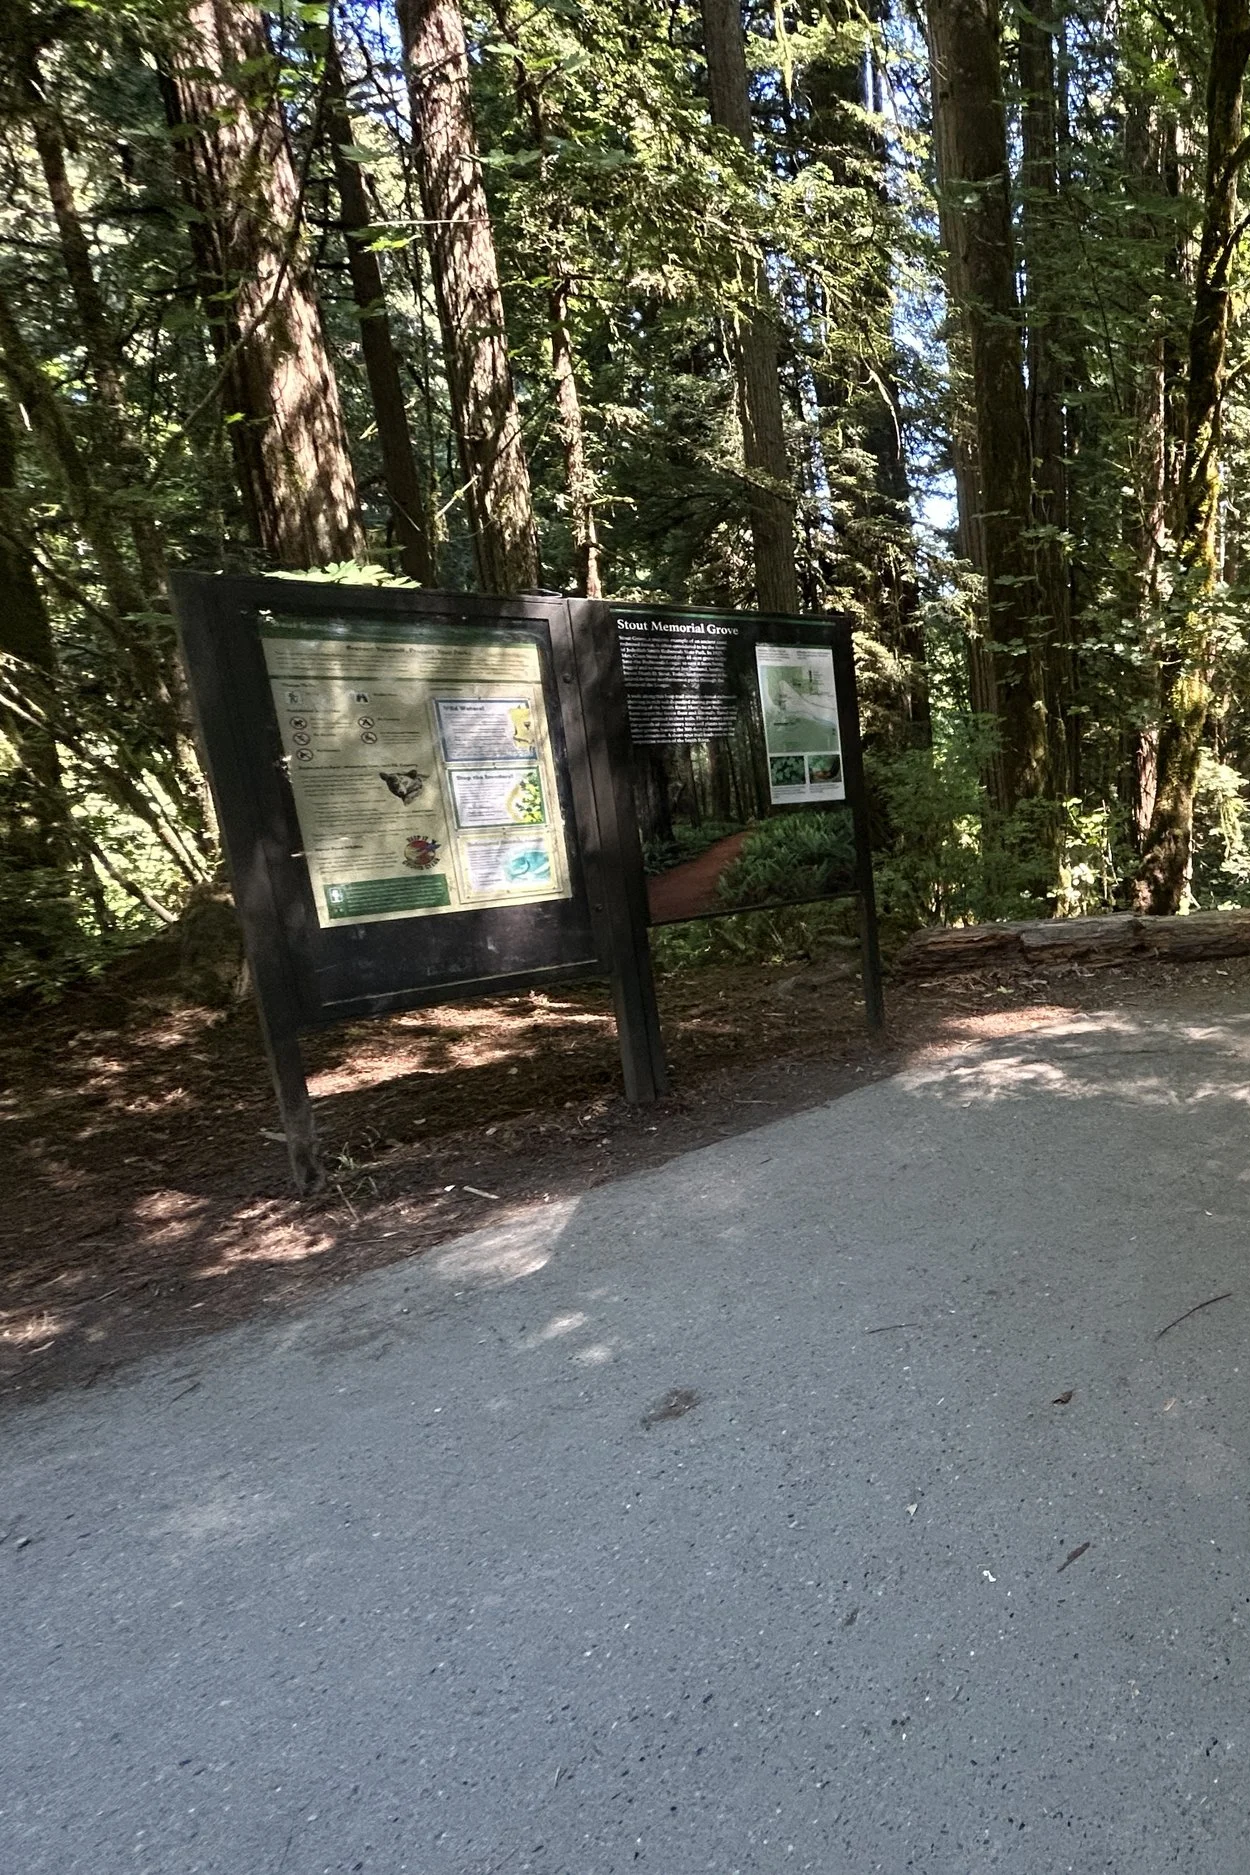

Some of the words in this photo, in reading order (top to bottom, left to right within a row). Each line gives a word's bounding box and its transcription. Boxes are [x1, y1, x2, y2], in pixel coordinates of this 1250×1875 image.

[617, 619, 648, 630] Stout
[651, 621, 705, 634] Memorial
[706, 624, 739, 635] Grove
